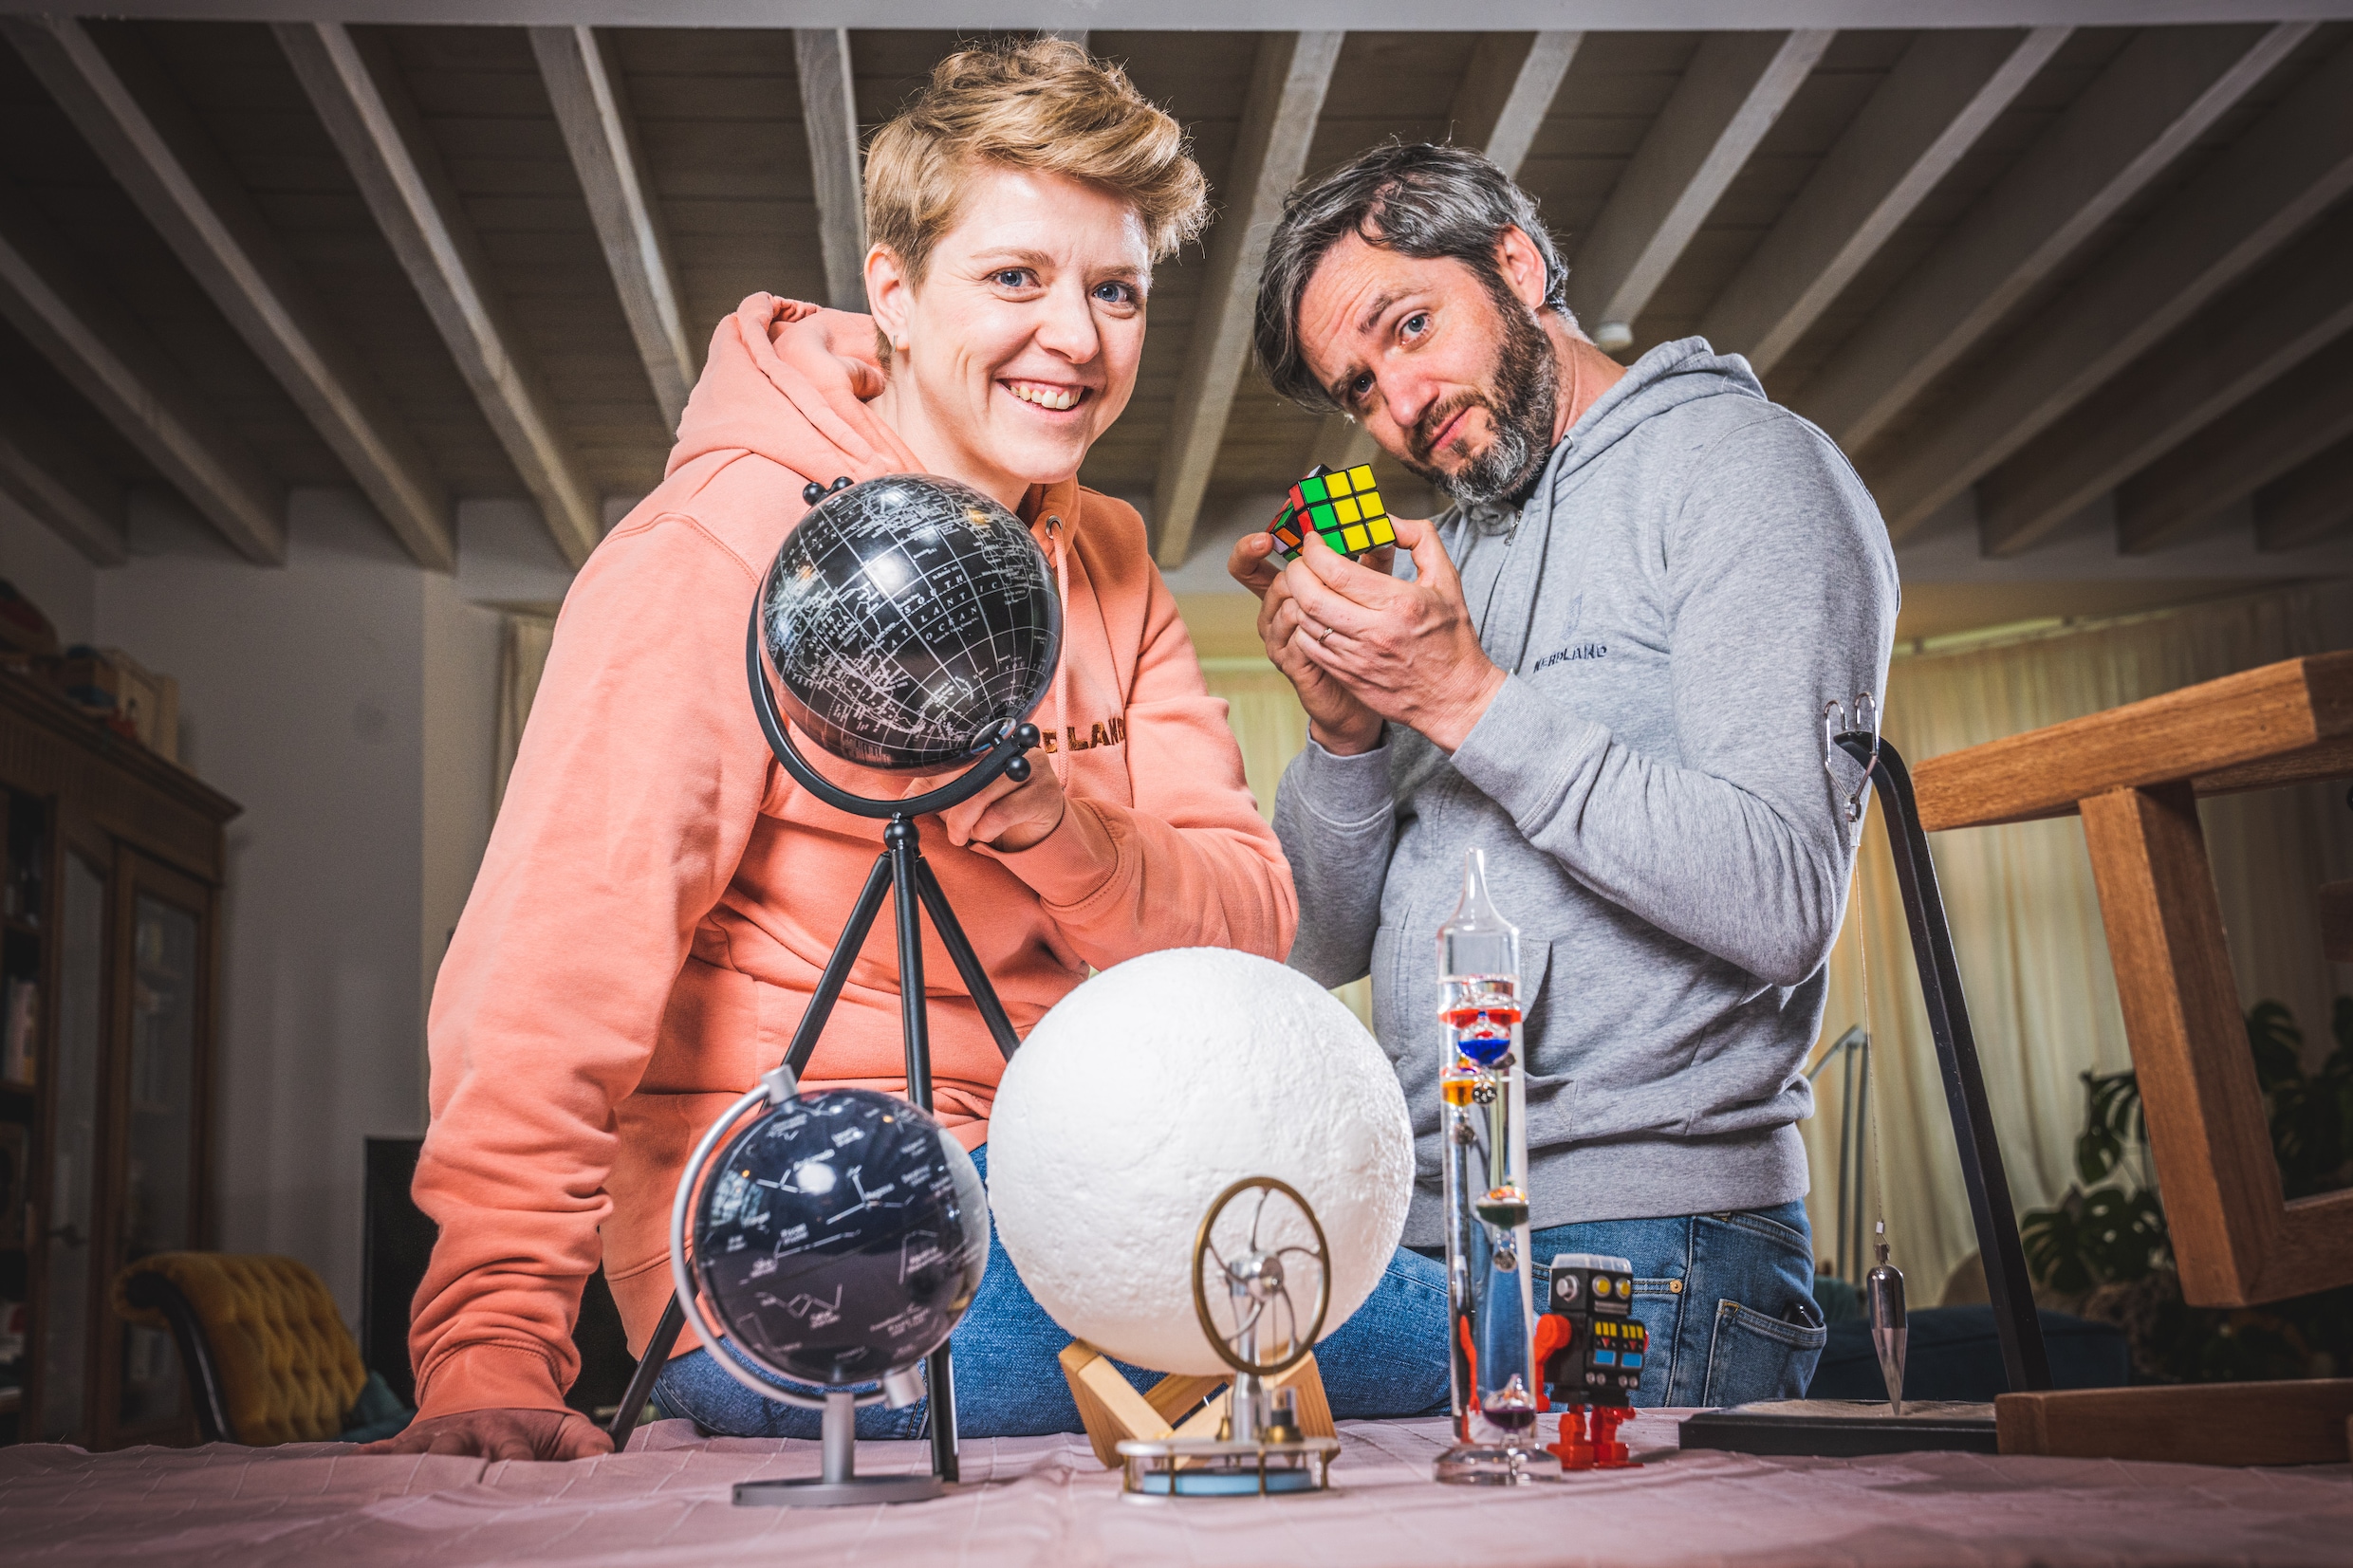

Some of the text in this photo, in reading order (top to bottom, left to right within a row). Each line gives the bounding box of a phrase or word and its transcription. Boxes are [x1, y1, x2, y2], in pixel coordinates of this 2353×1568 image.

[904, 574, 963, 615] SOUTH
[892, 581, 997, 648] ATLANTIC
[925, 605, 977, 641] OCEAN
[1533, 644, 1607, 673] NERDLAND
